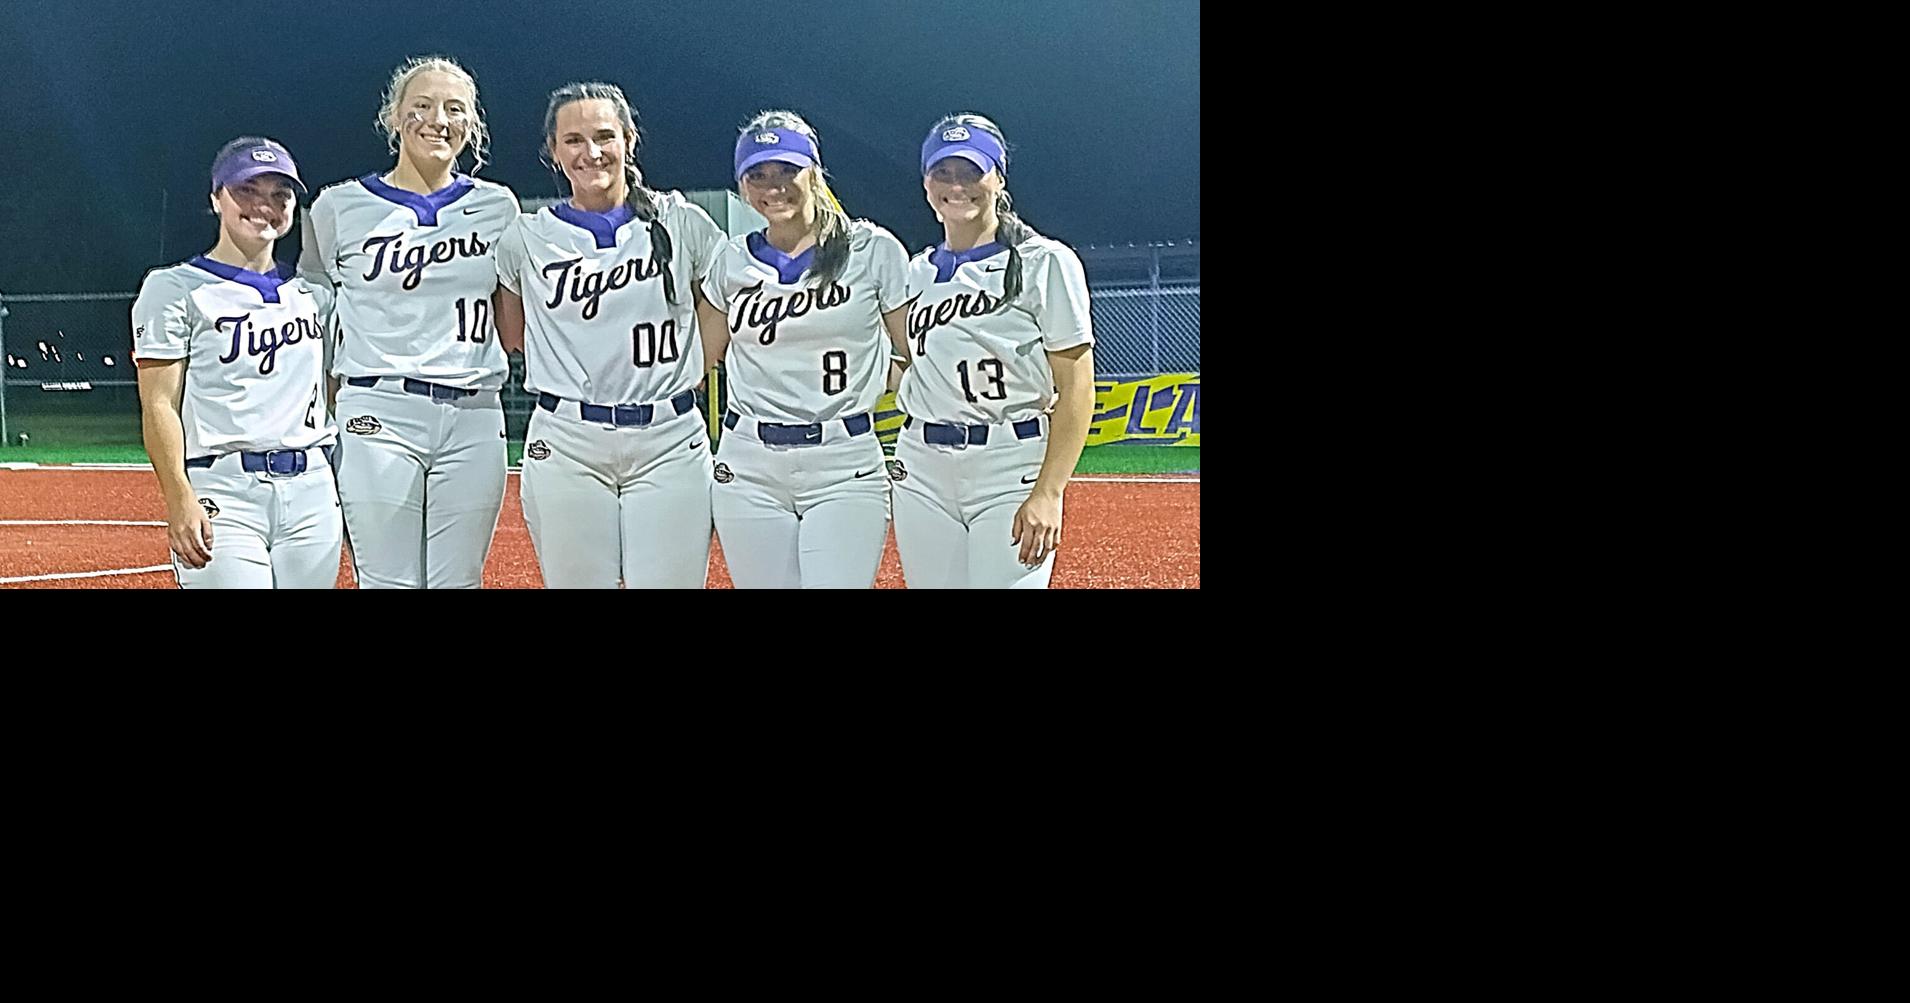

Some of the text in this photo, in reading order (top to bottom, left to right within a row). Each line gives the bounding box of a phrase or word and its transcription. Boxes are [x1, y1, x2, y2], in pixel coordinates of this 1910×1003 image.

[362, 231, 491, 290] Tigers
[541, 256, 662, 320] Tigers
[455, 297, 488, 343] 10
[730, 280, 851, 345] Tigers
[908, 290, 1003, 356] igers
[215, 312, 323, 375] Tigers
[633, 319, 679, 368] 00
[823, 350, 848, 396] 8
[957, 358, 1007, 403] 13
